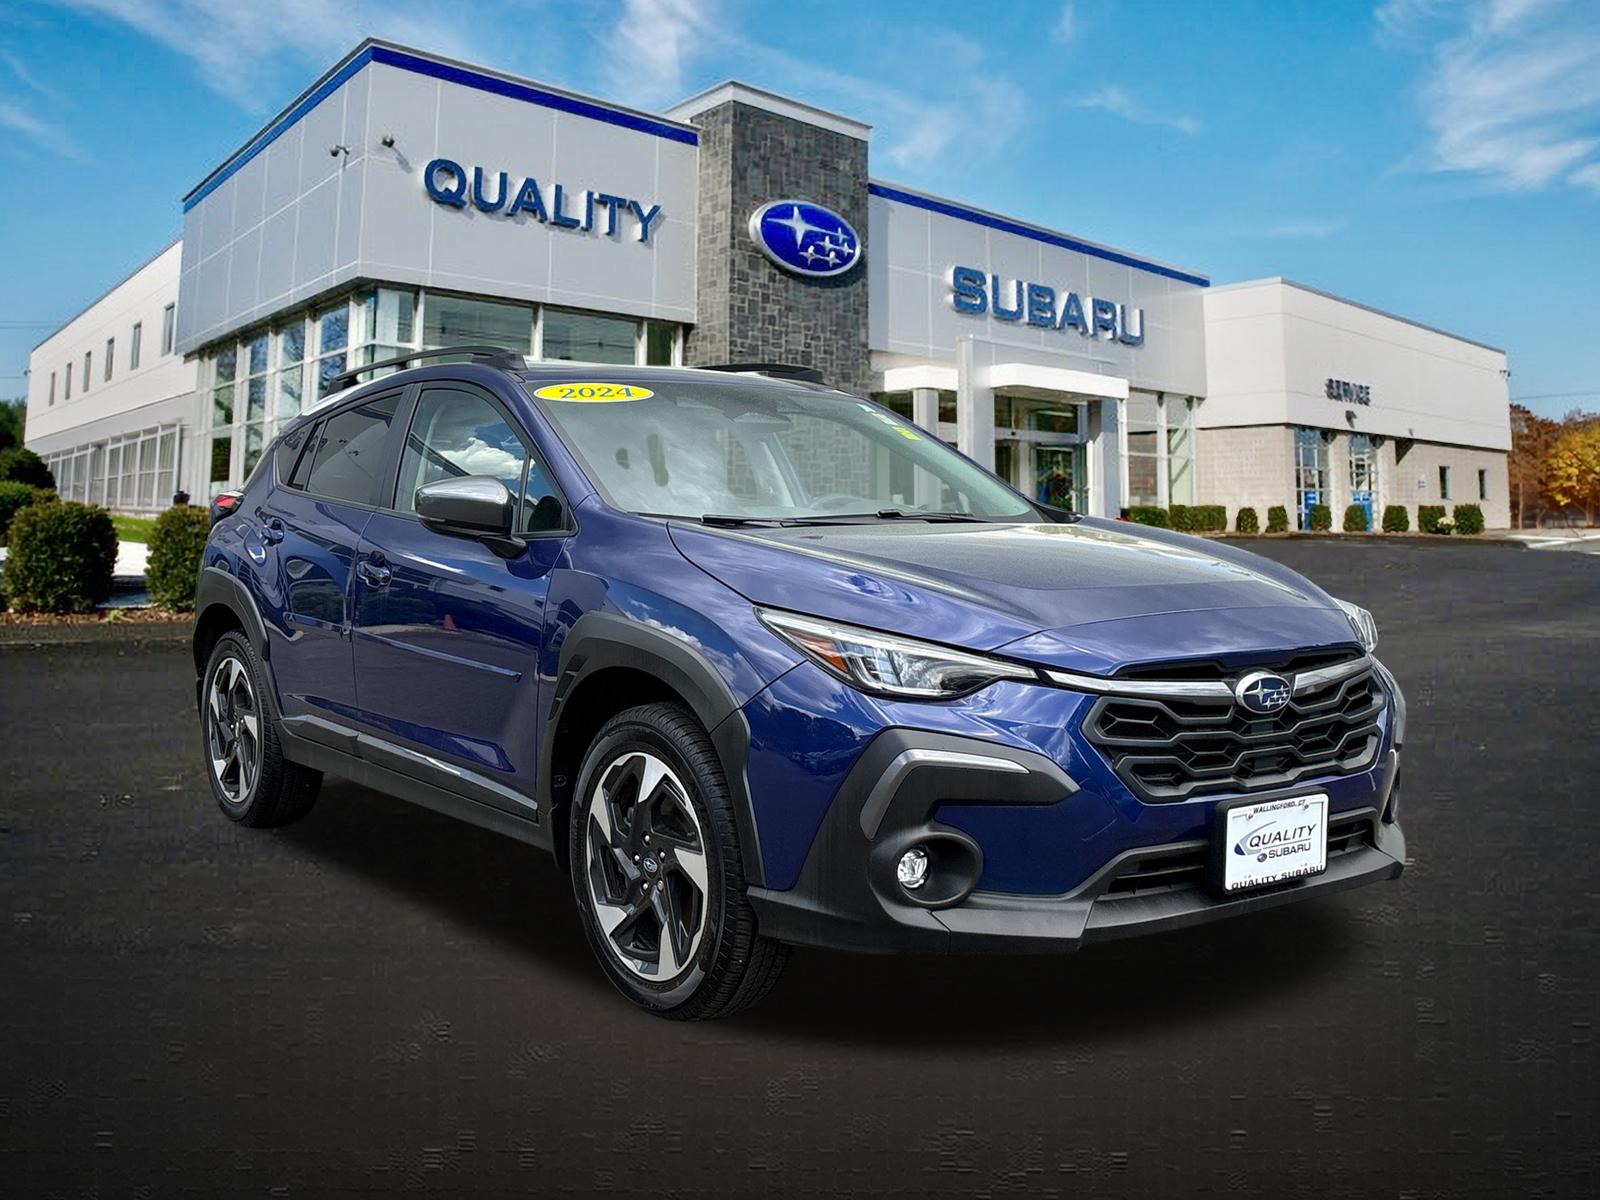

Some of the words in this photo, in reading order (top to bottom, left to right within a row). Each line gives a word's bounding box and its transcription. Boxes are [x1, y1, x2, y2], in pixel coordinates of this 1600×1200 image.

[424, 158, 661, 242] QUALITY
[951, 265, 1145, 347] SUBARU
[559, 386, 634, 399] 2024
[1325, 378, 1371, 407] SERVICE
[1249, 823, 1317, 848] QUALITY
[1268, 842, 1312, 859] SUBARU
[1231, 873, 1278, 890] QUALITY
[1280, 864, 1323, 880] SUBARU
